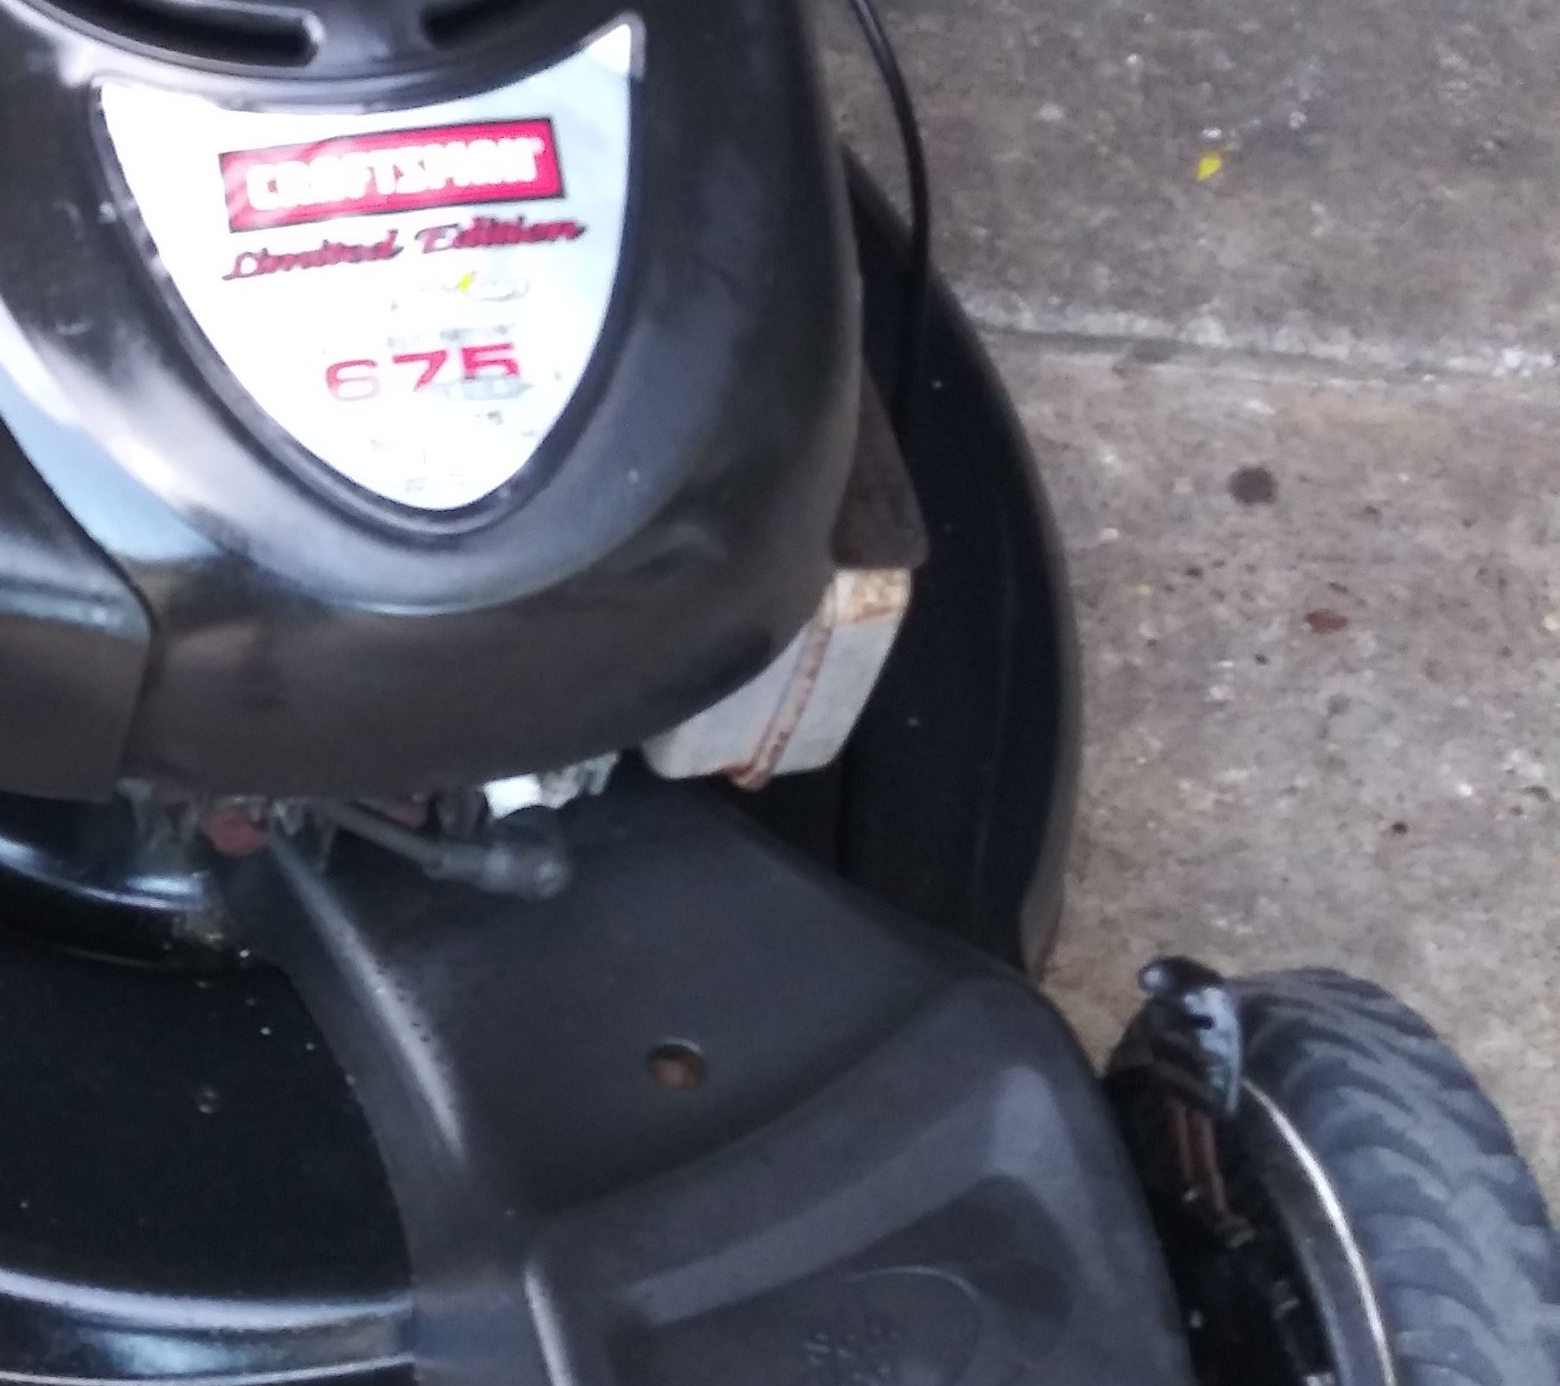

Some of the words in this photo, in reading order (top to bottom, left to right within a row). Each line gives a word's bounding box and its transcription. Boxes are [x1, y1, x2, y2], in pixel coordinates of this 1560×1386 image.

[221, 228, 404, 281] Limited
[413, 214, 588, 255] Edition
[324, 341, 523, 402] 675
